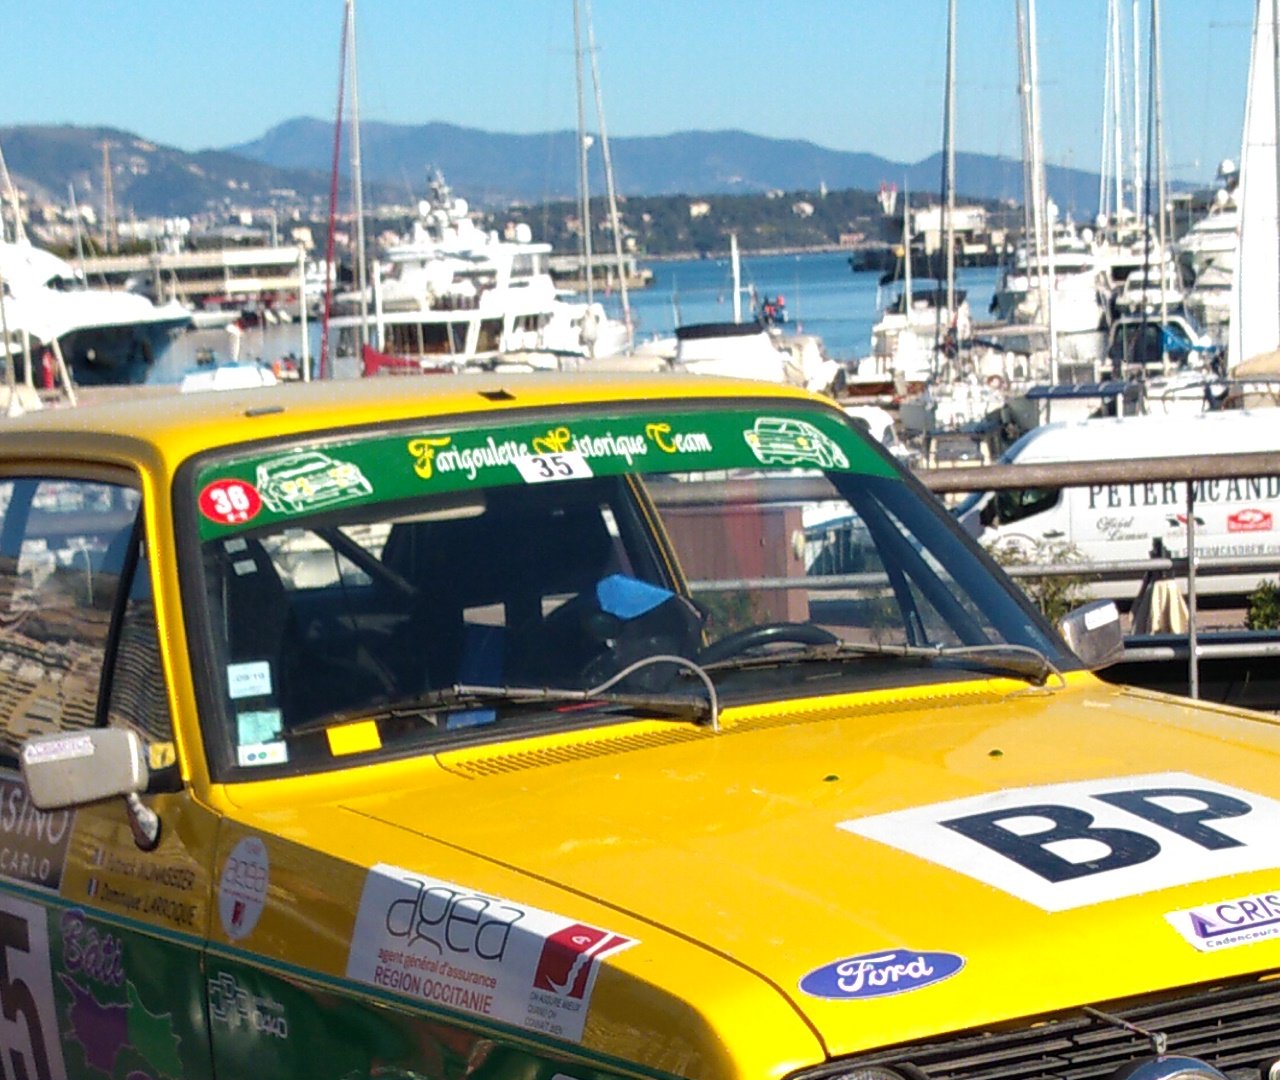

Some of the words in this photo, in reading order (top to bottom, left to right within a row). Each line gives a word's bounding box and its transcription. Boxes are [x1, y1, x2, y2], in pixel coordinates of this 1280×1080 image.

[645, 421, 713, 453] Team
[531, 456, 575, 479] 35
[1088, 480, 1178, 509] PETER
[937, 787, 1254, 884] BP
[1206, 927, 1280, 948] Cadenceurs
[378, 947, 404, 965] agent
[403, 954, 440, 975] général
[439, 960, 497, 989] d'assurance
[836, 953, 934, 993] Ford
[423, 978, 494, 1014] OCCITANIE
